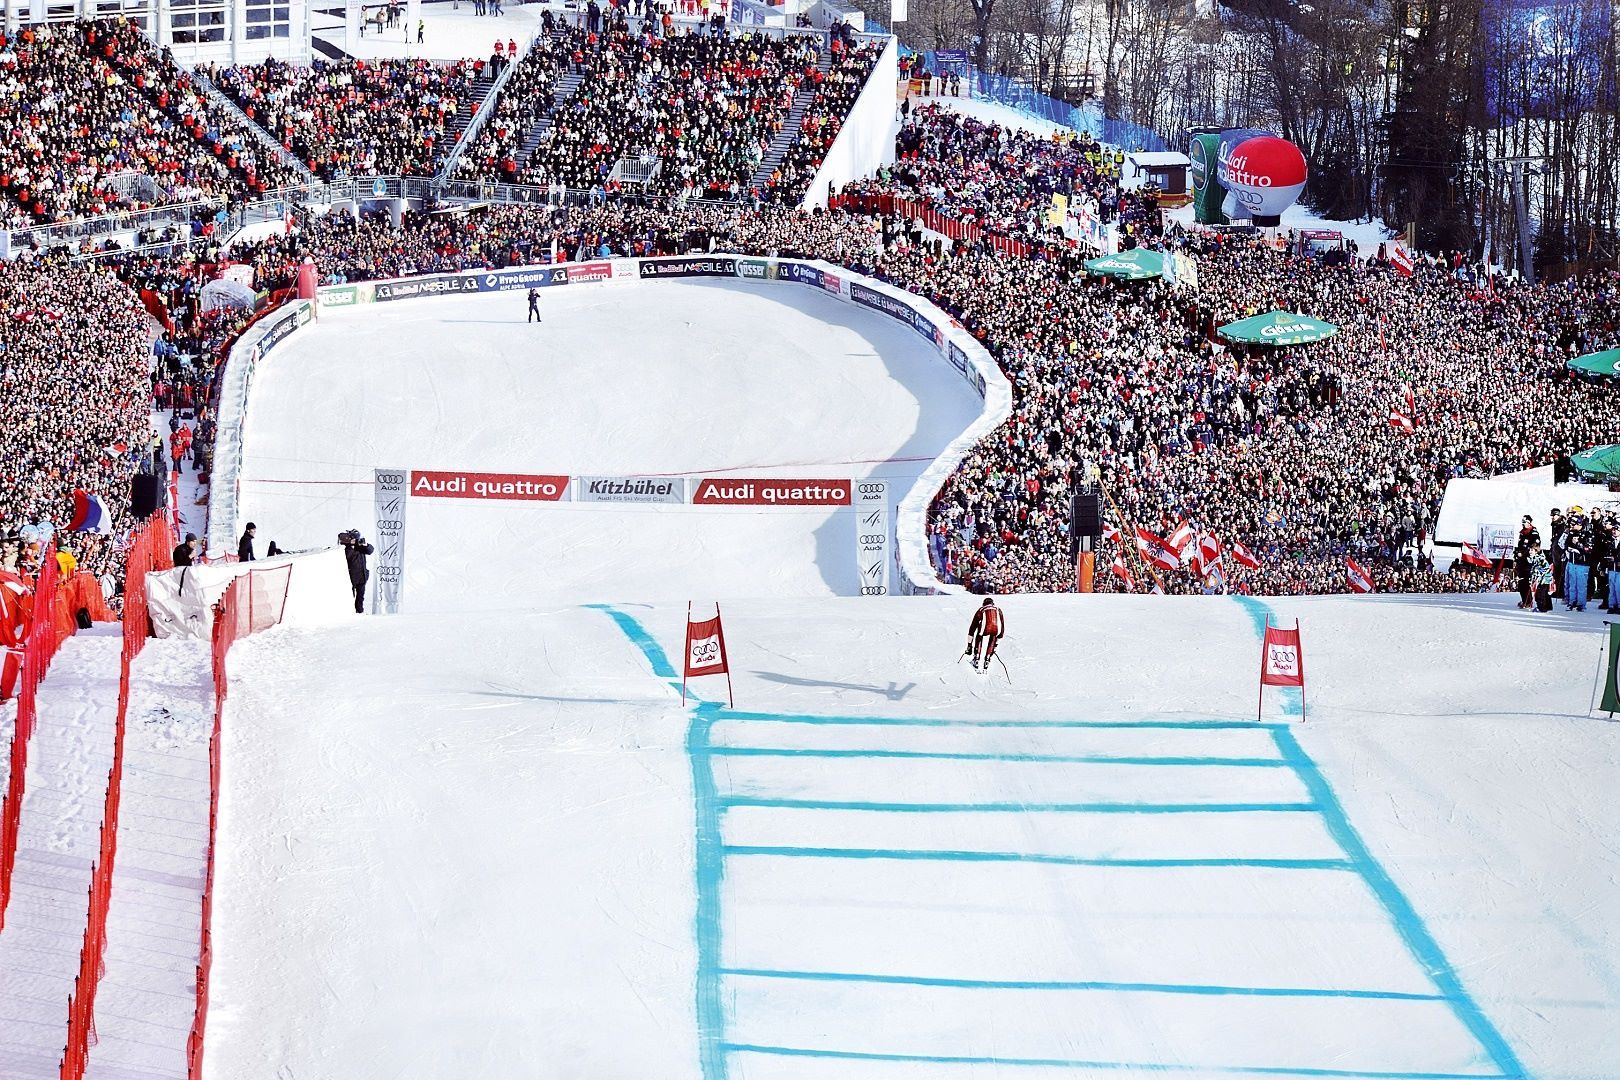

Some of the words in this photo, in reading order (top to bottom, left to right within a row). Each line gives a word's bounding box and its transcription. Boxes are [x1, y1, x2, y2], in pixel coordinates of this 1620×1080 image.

[641, 263, 657, 275] A1
[684, 262, 722, 273] MOBILE
[723, 262, 735, 273] A1
[551, 270, 567, 282] A1
[569, 272, 609, 283] quattro
[377, 286, 392, 298] A1
[419, 279, 460, 293] MOBILE
[462, 278, 479, 289] A1
[415, 476, 467, 492] Audi
[473, 479, 557, 496] quattro
[589, 479, 672, 495] Kitzbühel
[703, 484, 755, 499] Audi
[762, 486, 846, 502] quattro
[695, 654, 716, 664] Audi
[1272, 662, 1292, 671] Audi
